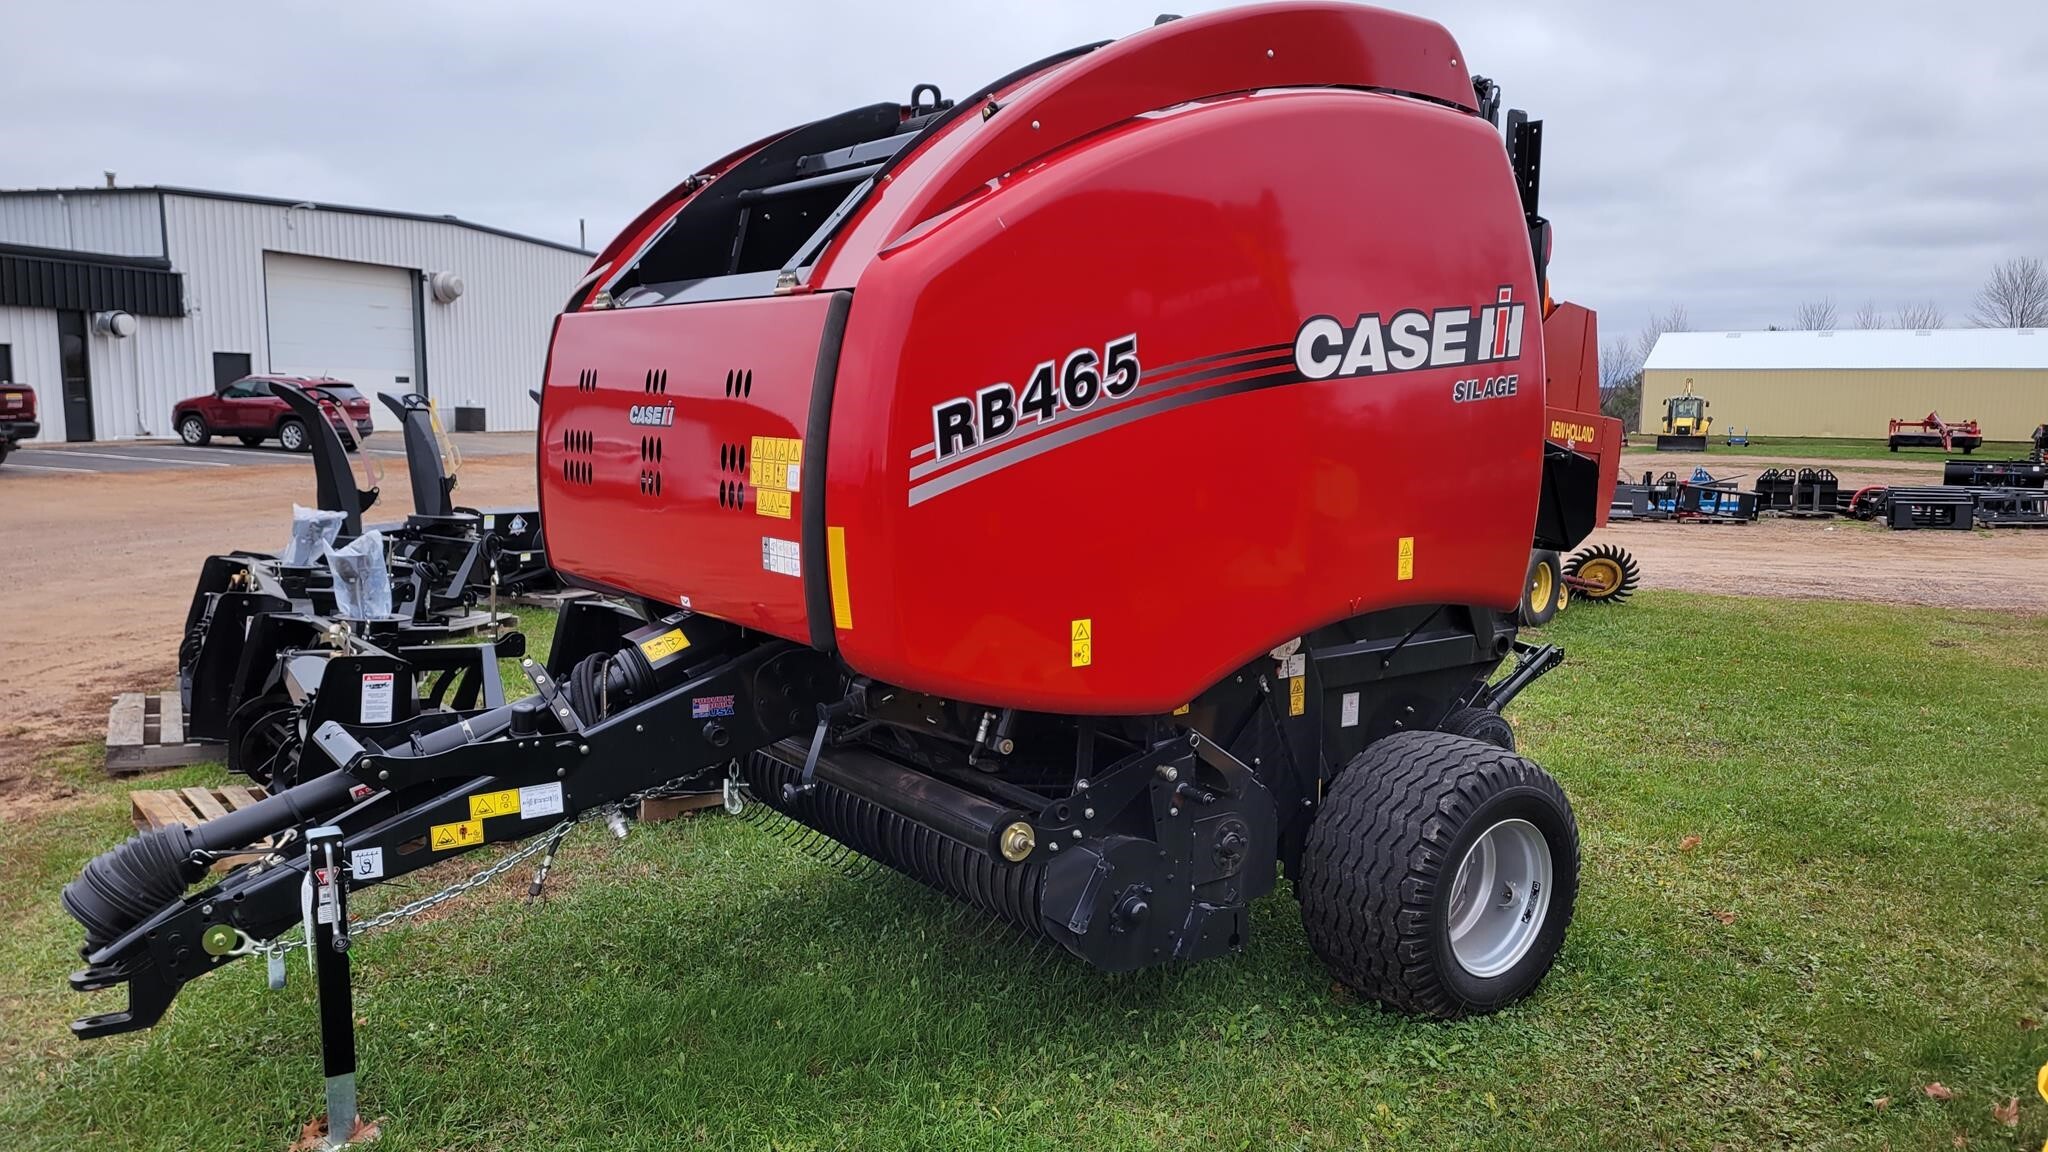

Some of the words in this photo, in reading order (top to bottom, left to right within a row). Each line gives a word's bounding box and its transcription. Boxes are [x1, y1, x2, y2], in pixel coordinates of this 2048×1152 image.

[1295, 309, 1471, 379] CASE
[932, 332, 1141, 463] RB465
[1453, 375, 1518, 403] SILAGE
[629, 405, 662, 425] CASE
[1565, 423, 1595, 443] HOLLAND
